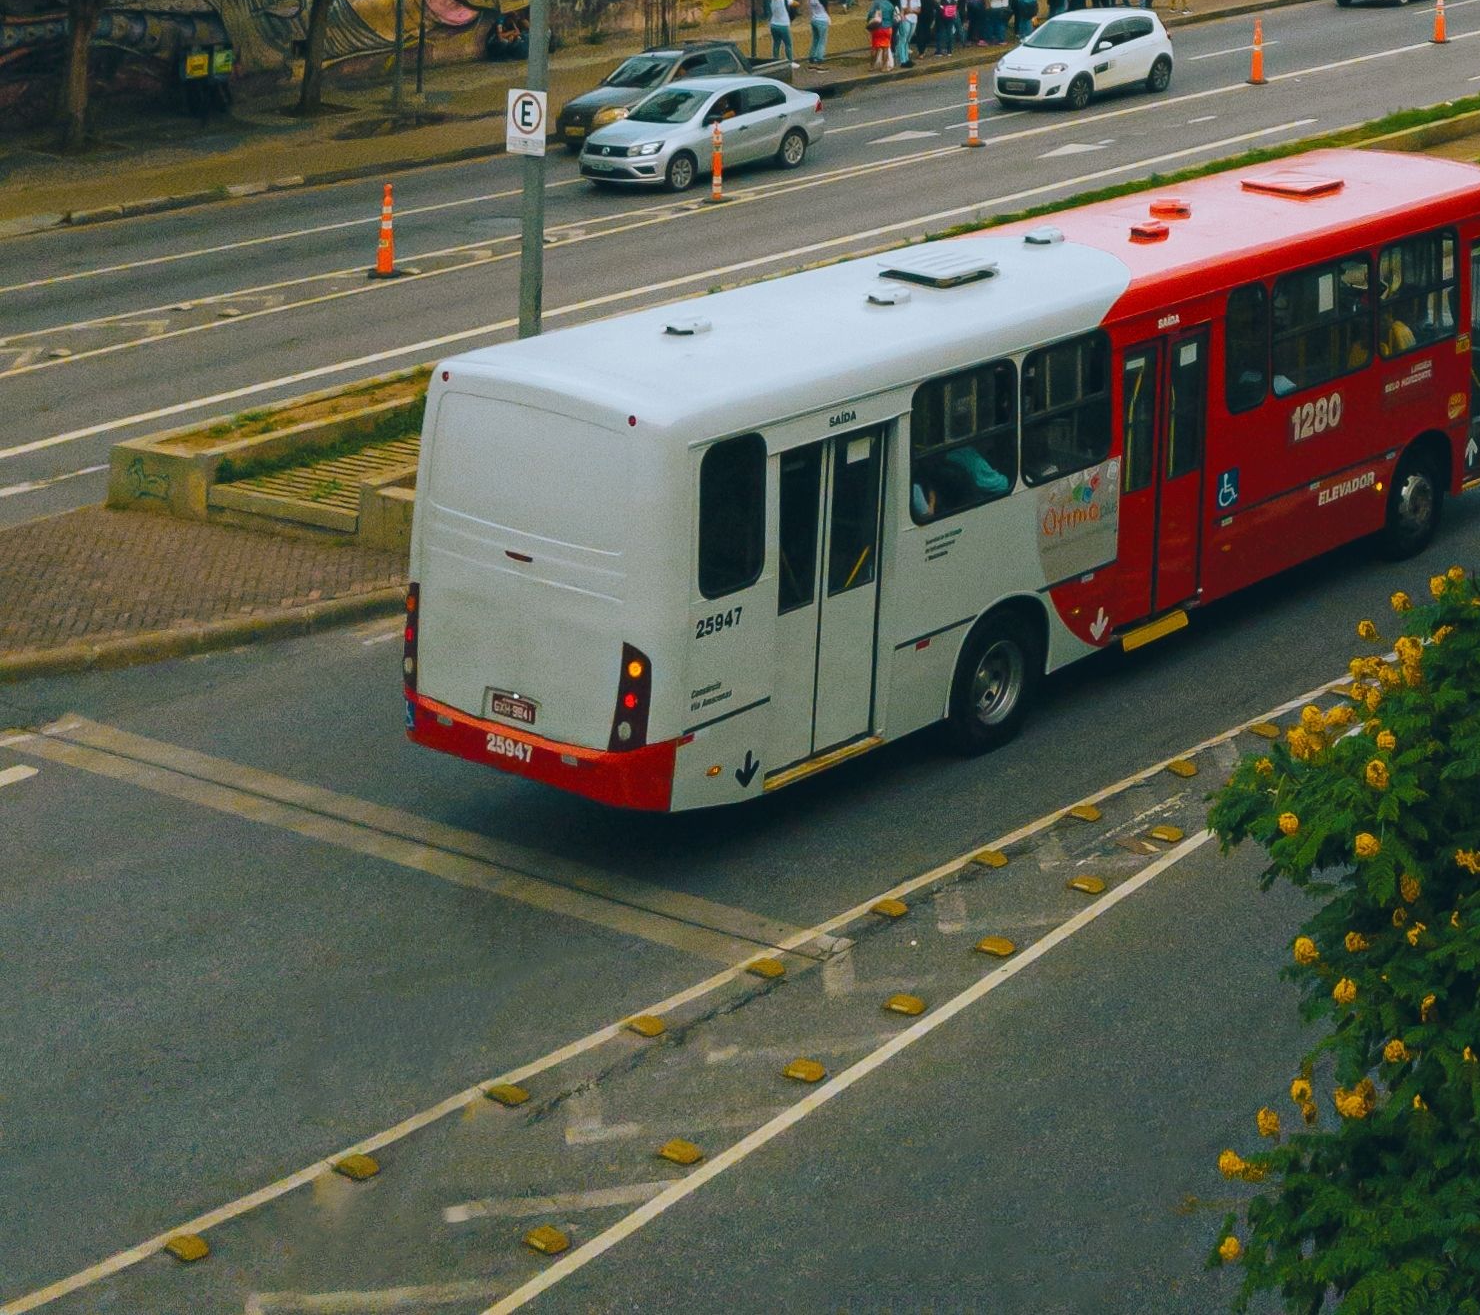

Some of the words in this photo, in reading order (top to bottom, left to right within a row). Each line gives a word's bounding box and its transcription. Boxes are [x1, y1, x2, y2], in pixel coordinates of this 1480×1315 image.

[521, 101, 533, 126] E
[829, 410, 857, 427] SAÍDA
[1291, 392, 1342, 441] 1280
[1318, 471, 1376, 506] ELEVADOR
[695, 606, 743, 640] 25947
[486, 732, 534, 763] 25947
